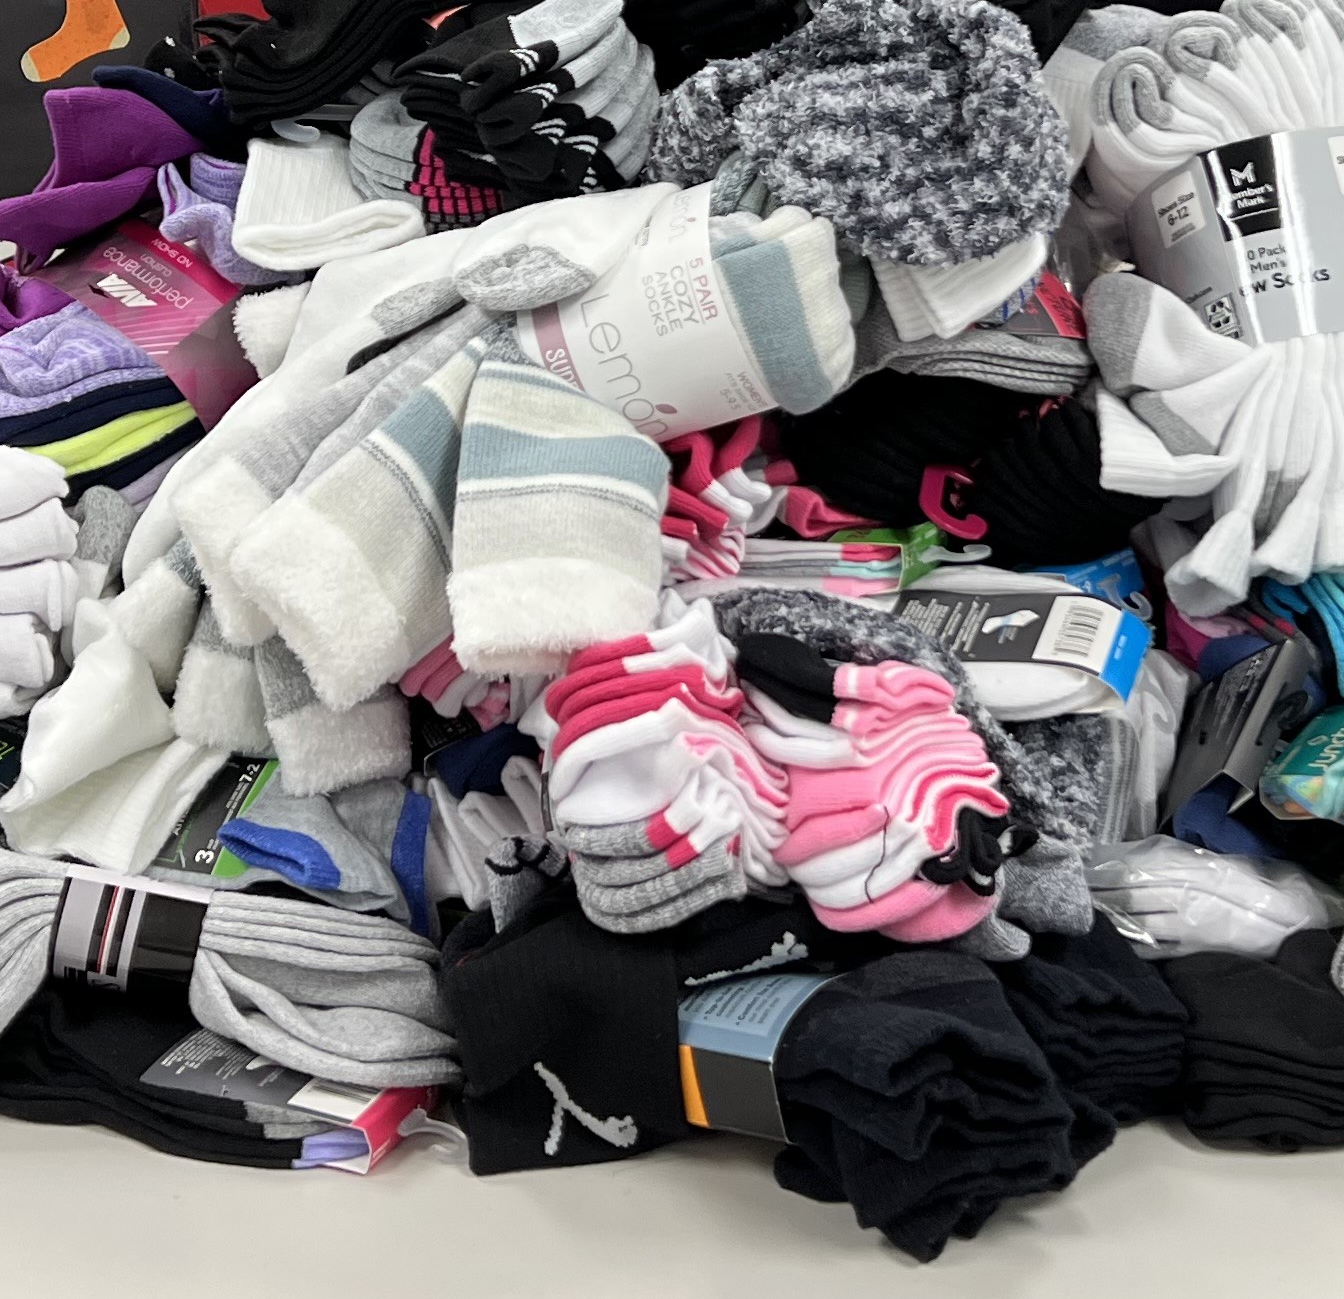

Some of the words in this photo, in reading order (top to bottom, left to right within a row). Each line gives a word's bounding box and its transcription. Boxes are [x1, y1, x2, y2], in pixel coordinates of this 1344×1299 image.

[1231, 183, 1274, 201] ember's
[150, 237, 179, 259] SHOW
[139, 252, 173, 277] cushion
[175, 254, 193, 268] NO
[689, 257, 704, 270] 5
[102, 246, 194, 310] performance
[640, 275, 669, 338] SOCKS
[655, 271, 684, 332] ANKLE
[669, 265, 700, 325] COZY
[695, 273, 719, 322] PAIR
[194, 849, 215, 864] 3
